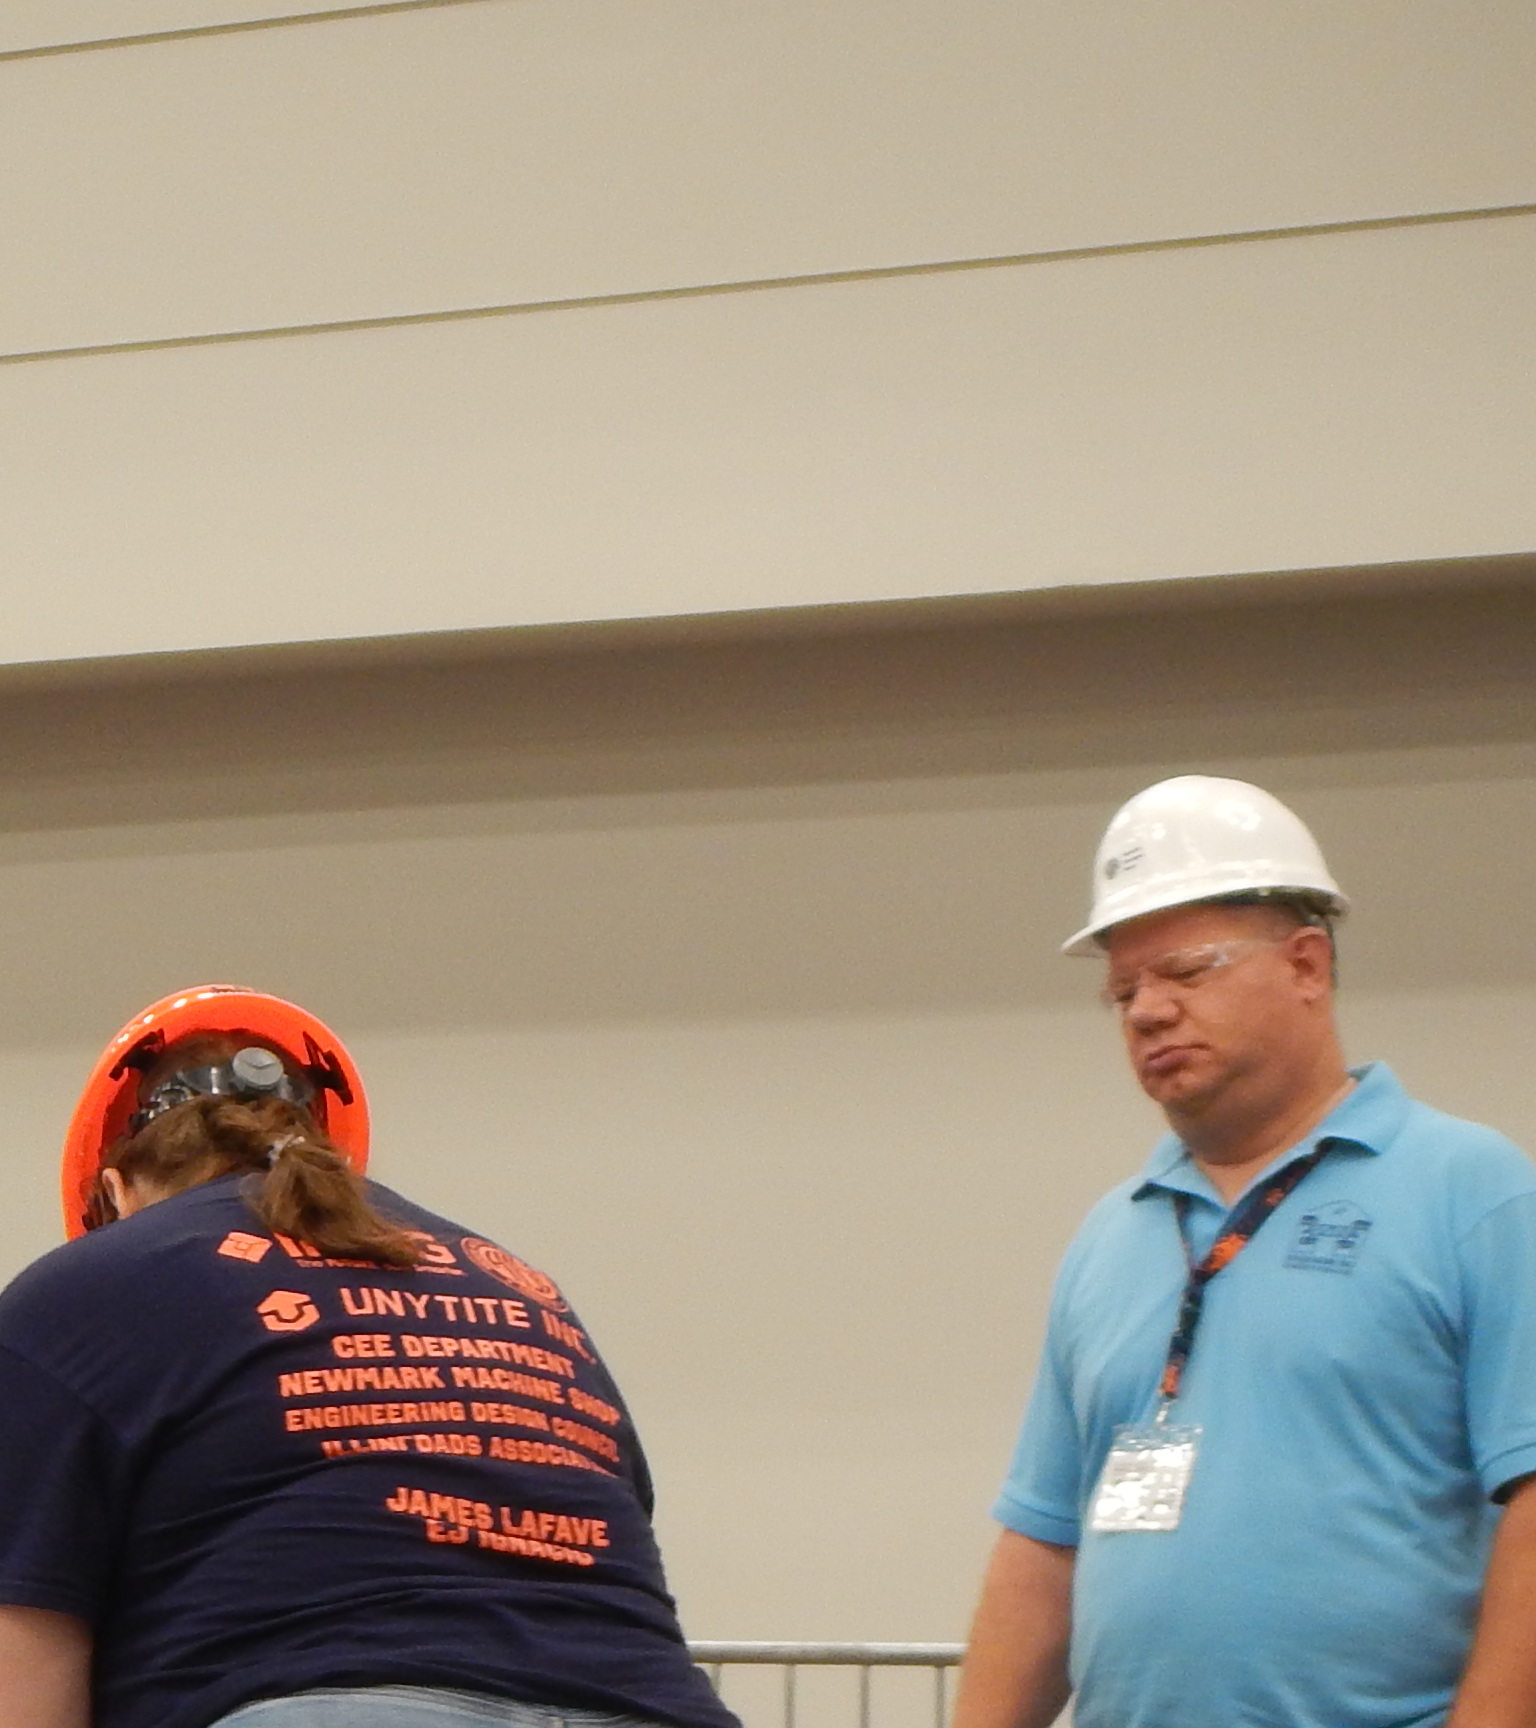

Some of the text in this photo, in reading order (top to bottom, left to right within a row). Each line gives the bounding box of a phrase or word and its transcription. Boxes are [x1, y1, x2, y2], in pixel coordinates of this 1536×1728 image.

[340, 1286, 531, 1329] UNYTITE
[332, 1334, 576, 1379] CEE DEPARTMENT
[279, 1366, 446, 1398] NEWMARK
[451, 1366, 566, 1405] MACHINE
[285, 1401, 466, 1432] ENGINEERING
[413, 1433, 483, 1456] DADS
[386, 1486, 611, 1548] JAMES LAFAVE
